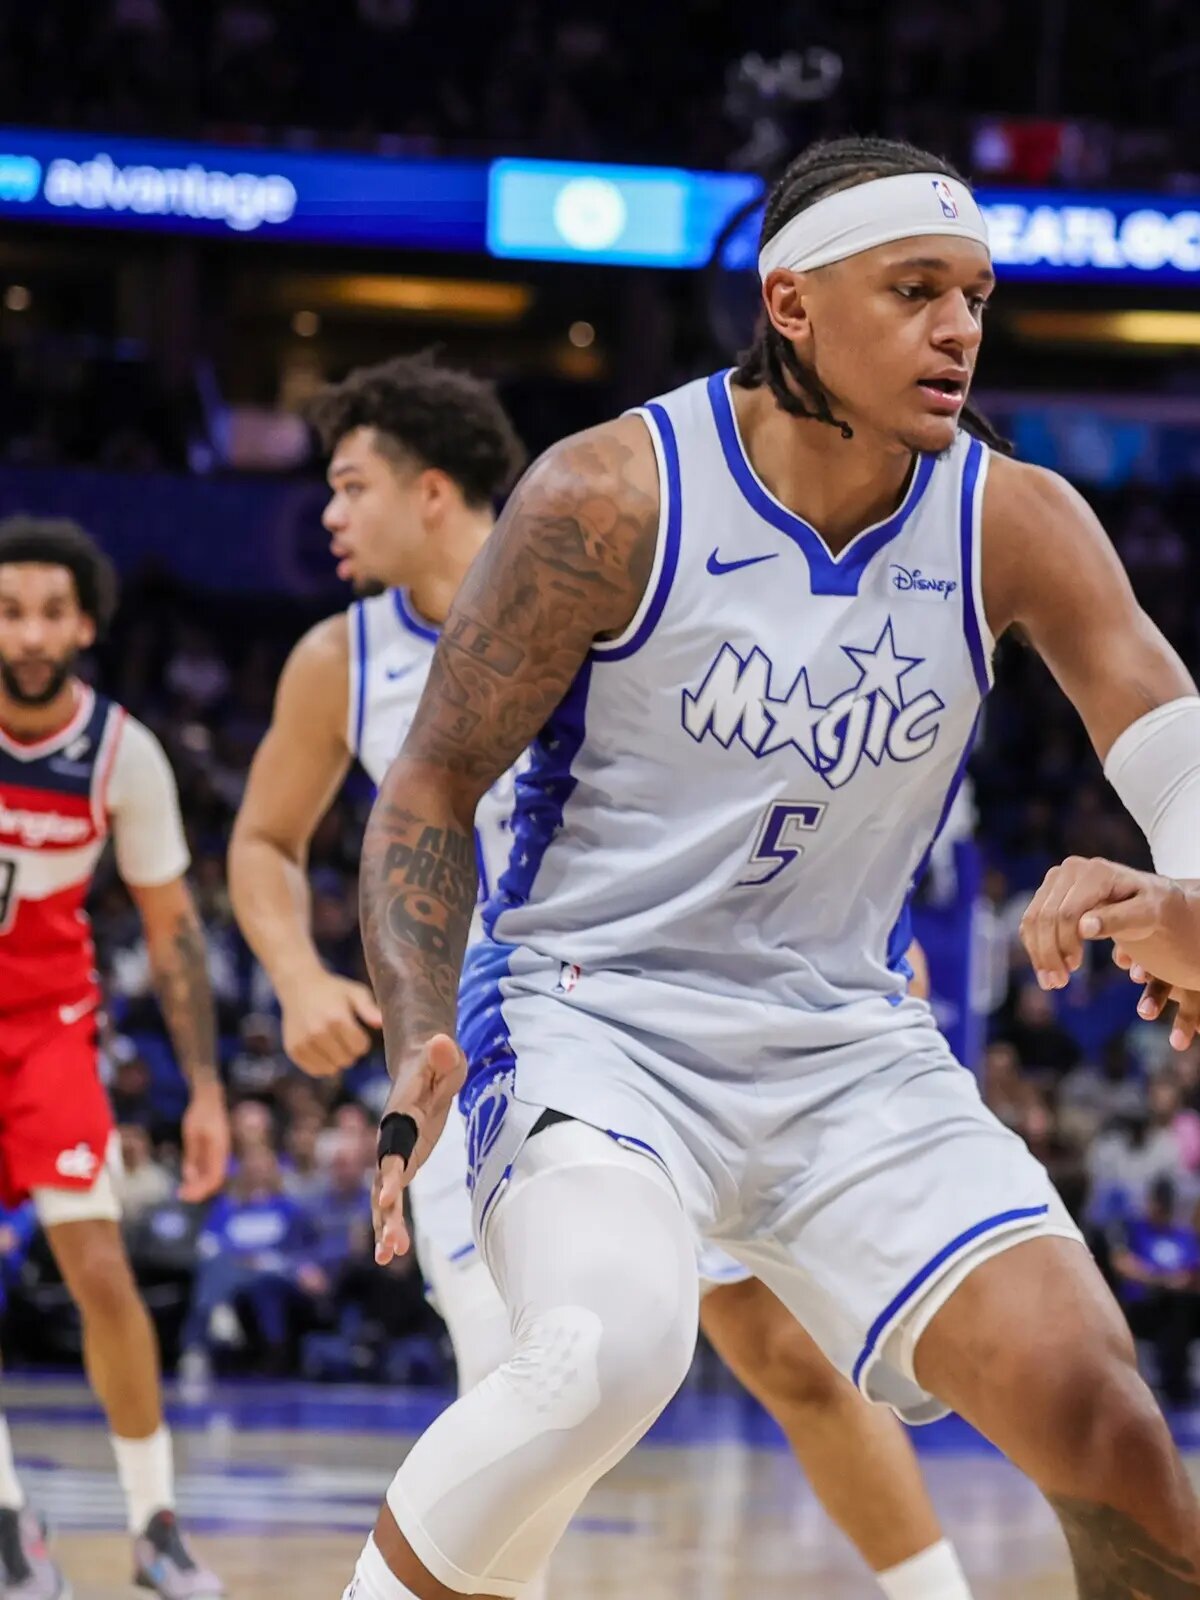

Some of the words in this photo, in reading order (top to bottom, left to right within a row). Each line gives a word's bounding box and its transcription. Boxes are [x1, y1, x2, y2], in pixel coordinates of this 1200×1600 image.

[44, 152, 297, 231] advantage
[890, 564, 957, 600] Disney
[732, 798, 830, 888] 5
